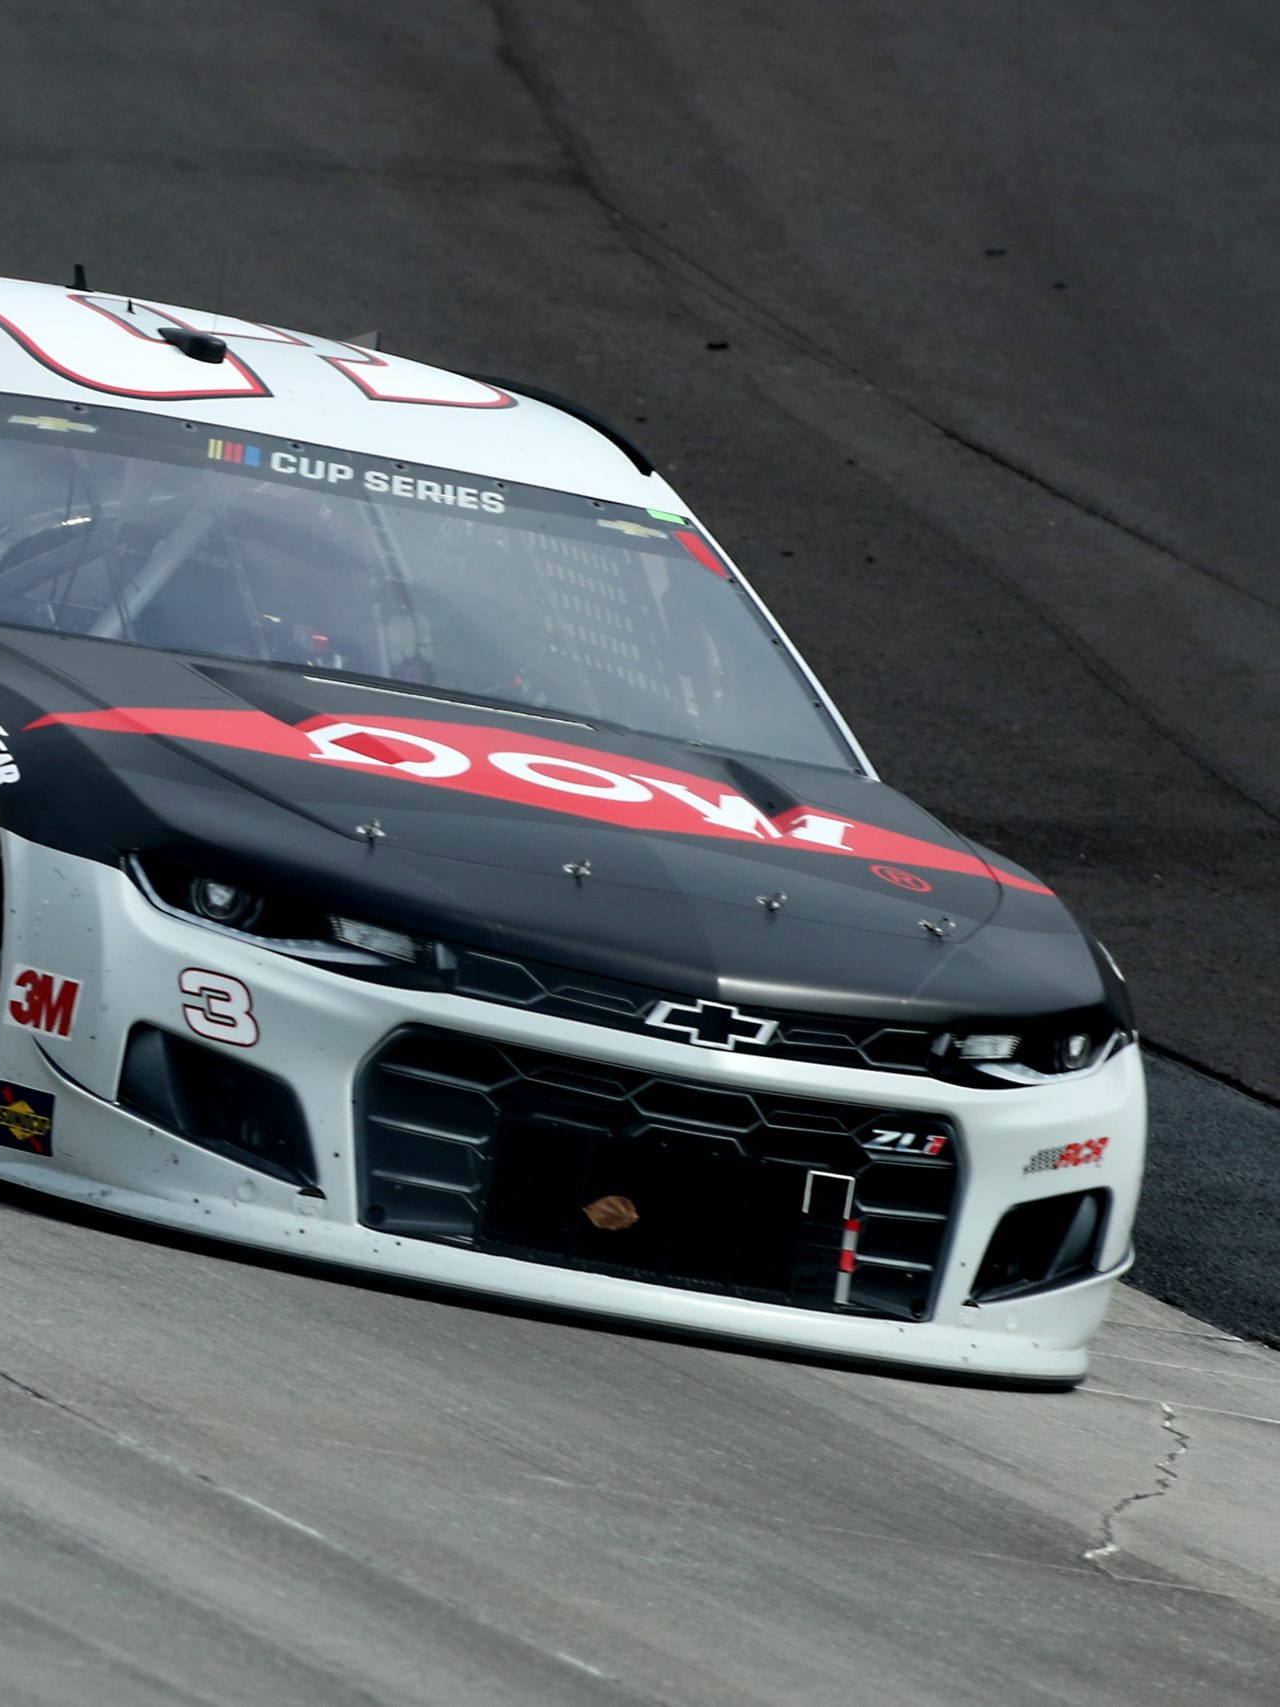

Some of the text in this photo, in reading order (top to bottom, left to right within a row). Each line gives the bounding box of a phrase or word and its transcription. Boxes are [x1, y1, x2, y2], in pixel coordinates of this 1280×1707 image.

[271, 451, 506, 515] CUP SERIES
[9, 969, 81, 1037] 3M
[178, 967, 260, 1047] 3
